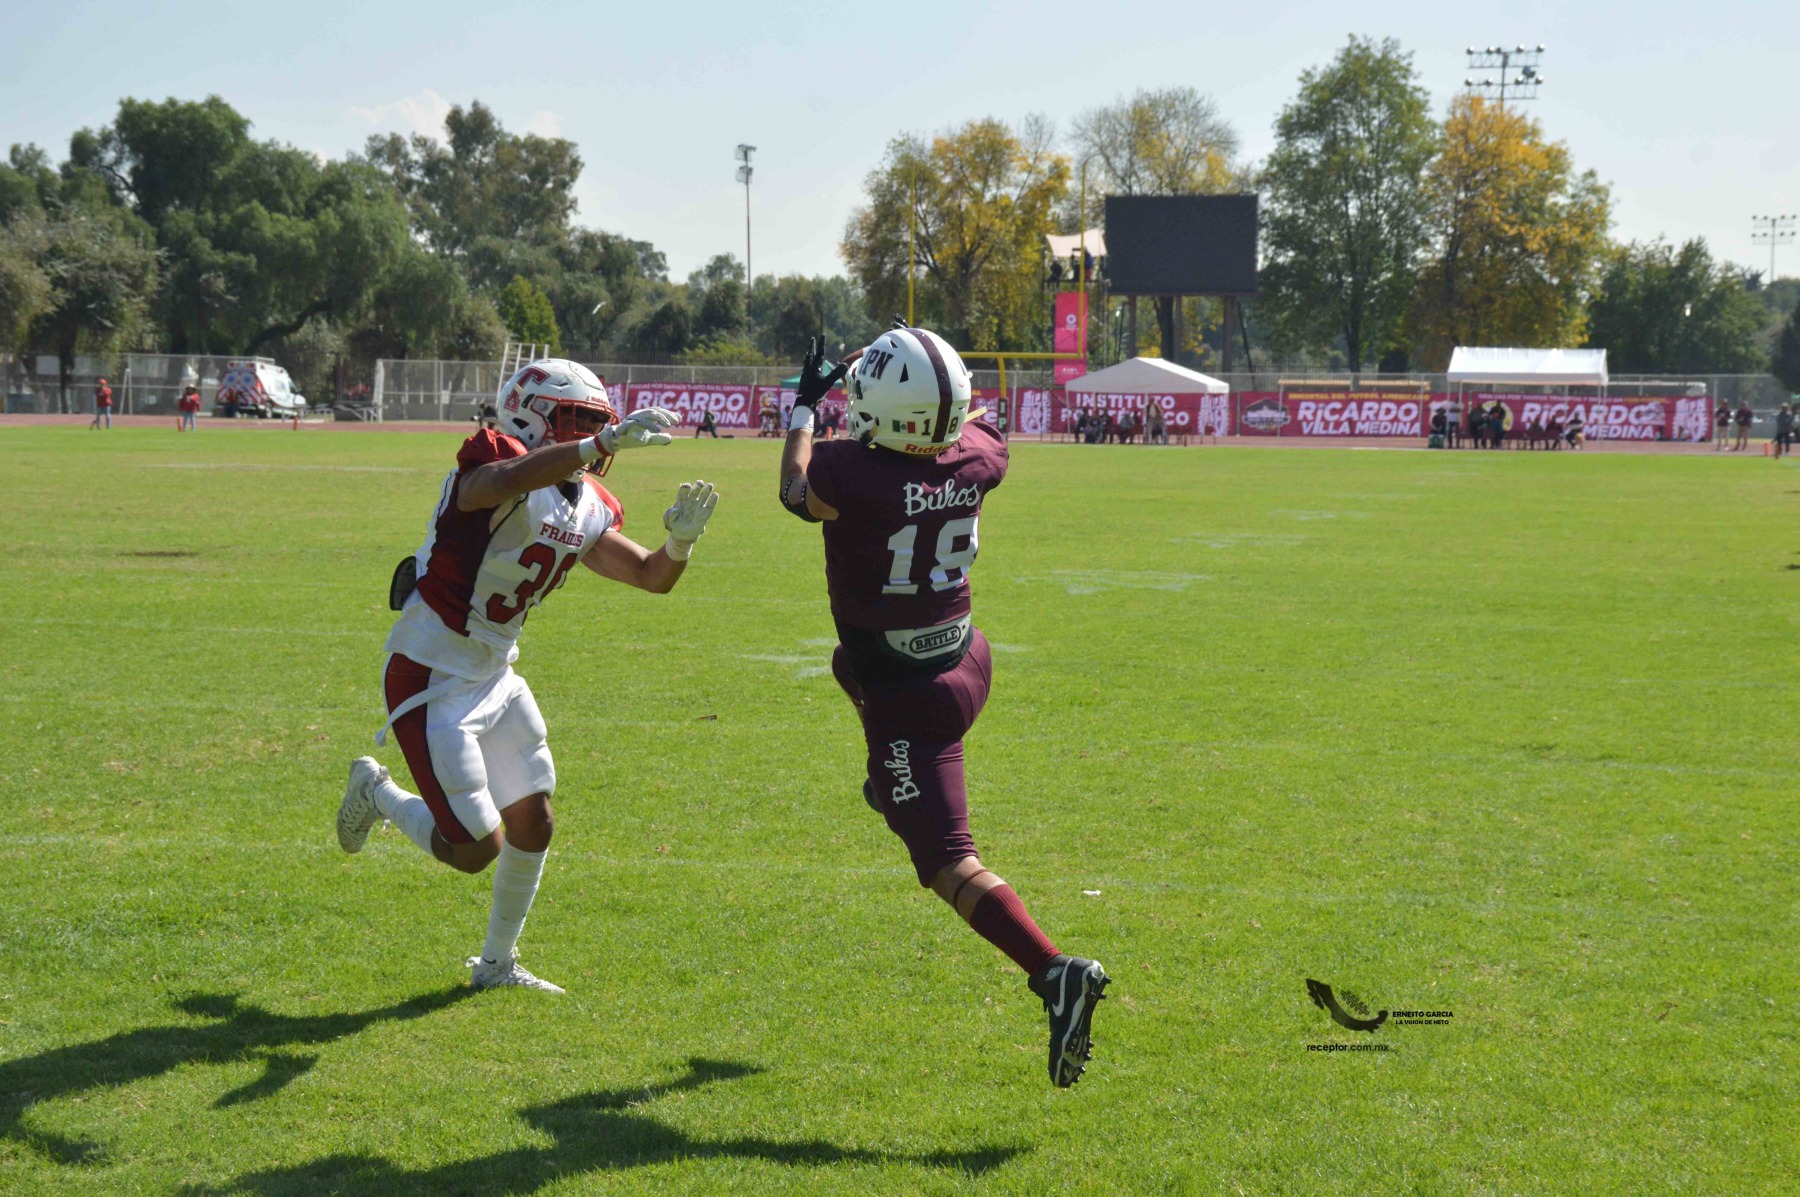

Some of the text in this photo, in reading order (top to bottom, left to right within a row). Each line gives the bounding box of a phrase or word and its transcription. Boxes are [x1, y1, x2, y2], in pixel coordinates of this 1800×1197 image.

[859, 349, 894, 380] IPN
[921, 416, 959, 436] 18
[1355, 421, 1421, 435] MEDINA
[1582, 424, 1654, 439] MEDINA
[539, 522, 584, 548] FRAILS
[881, 516, 979, 595] 18
[915, 628, 959, 651] BATTLE
